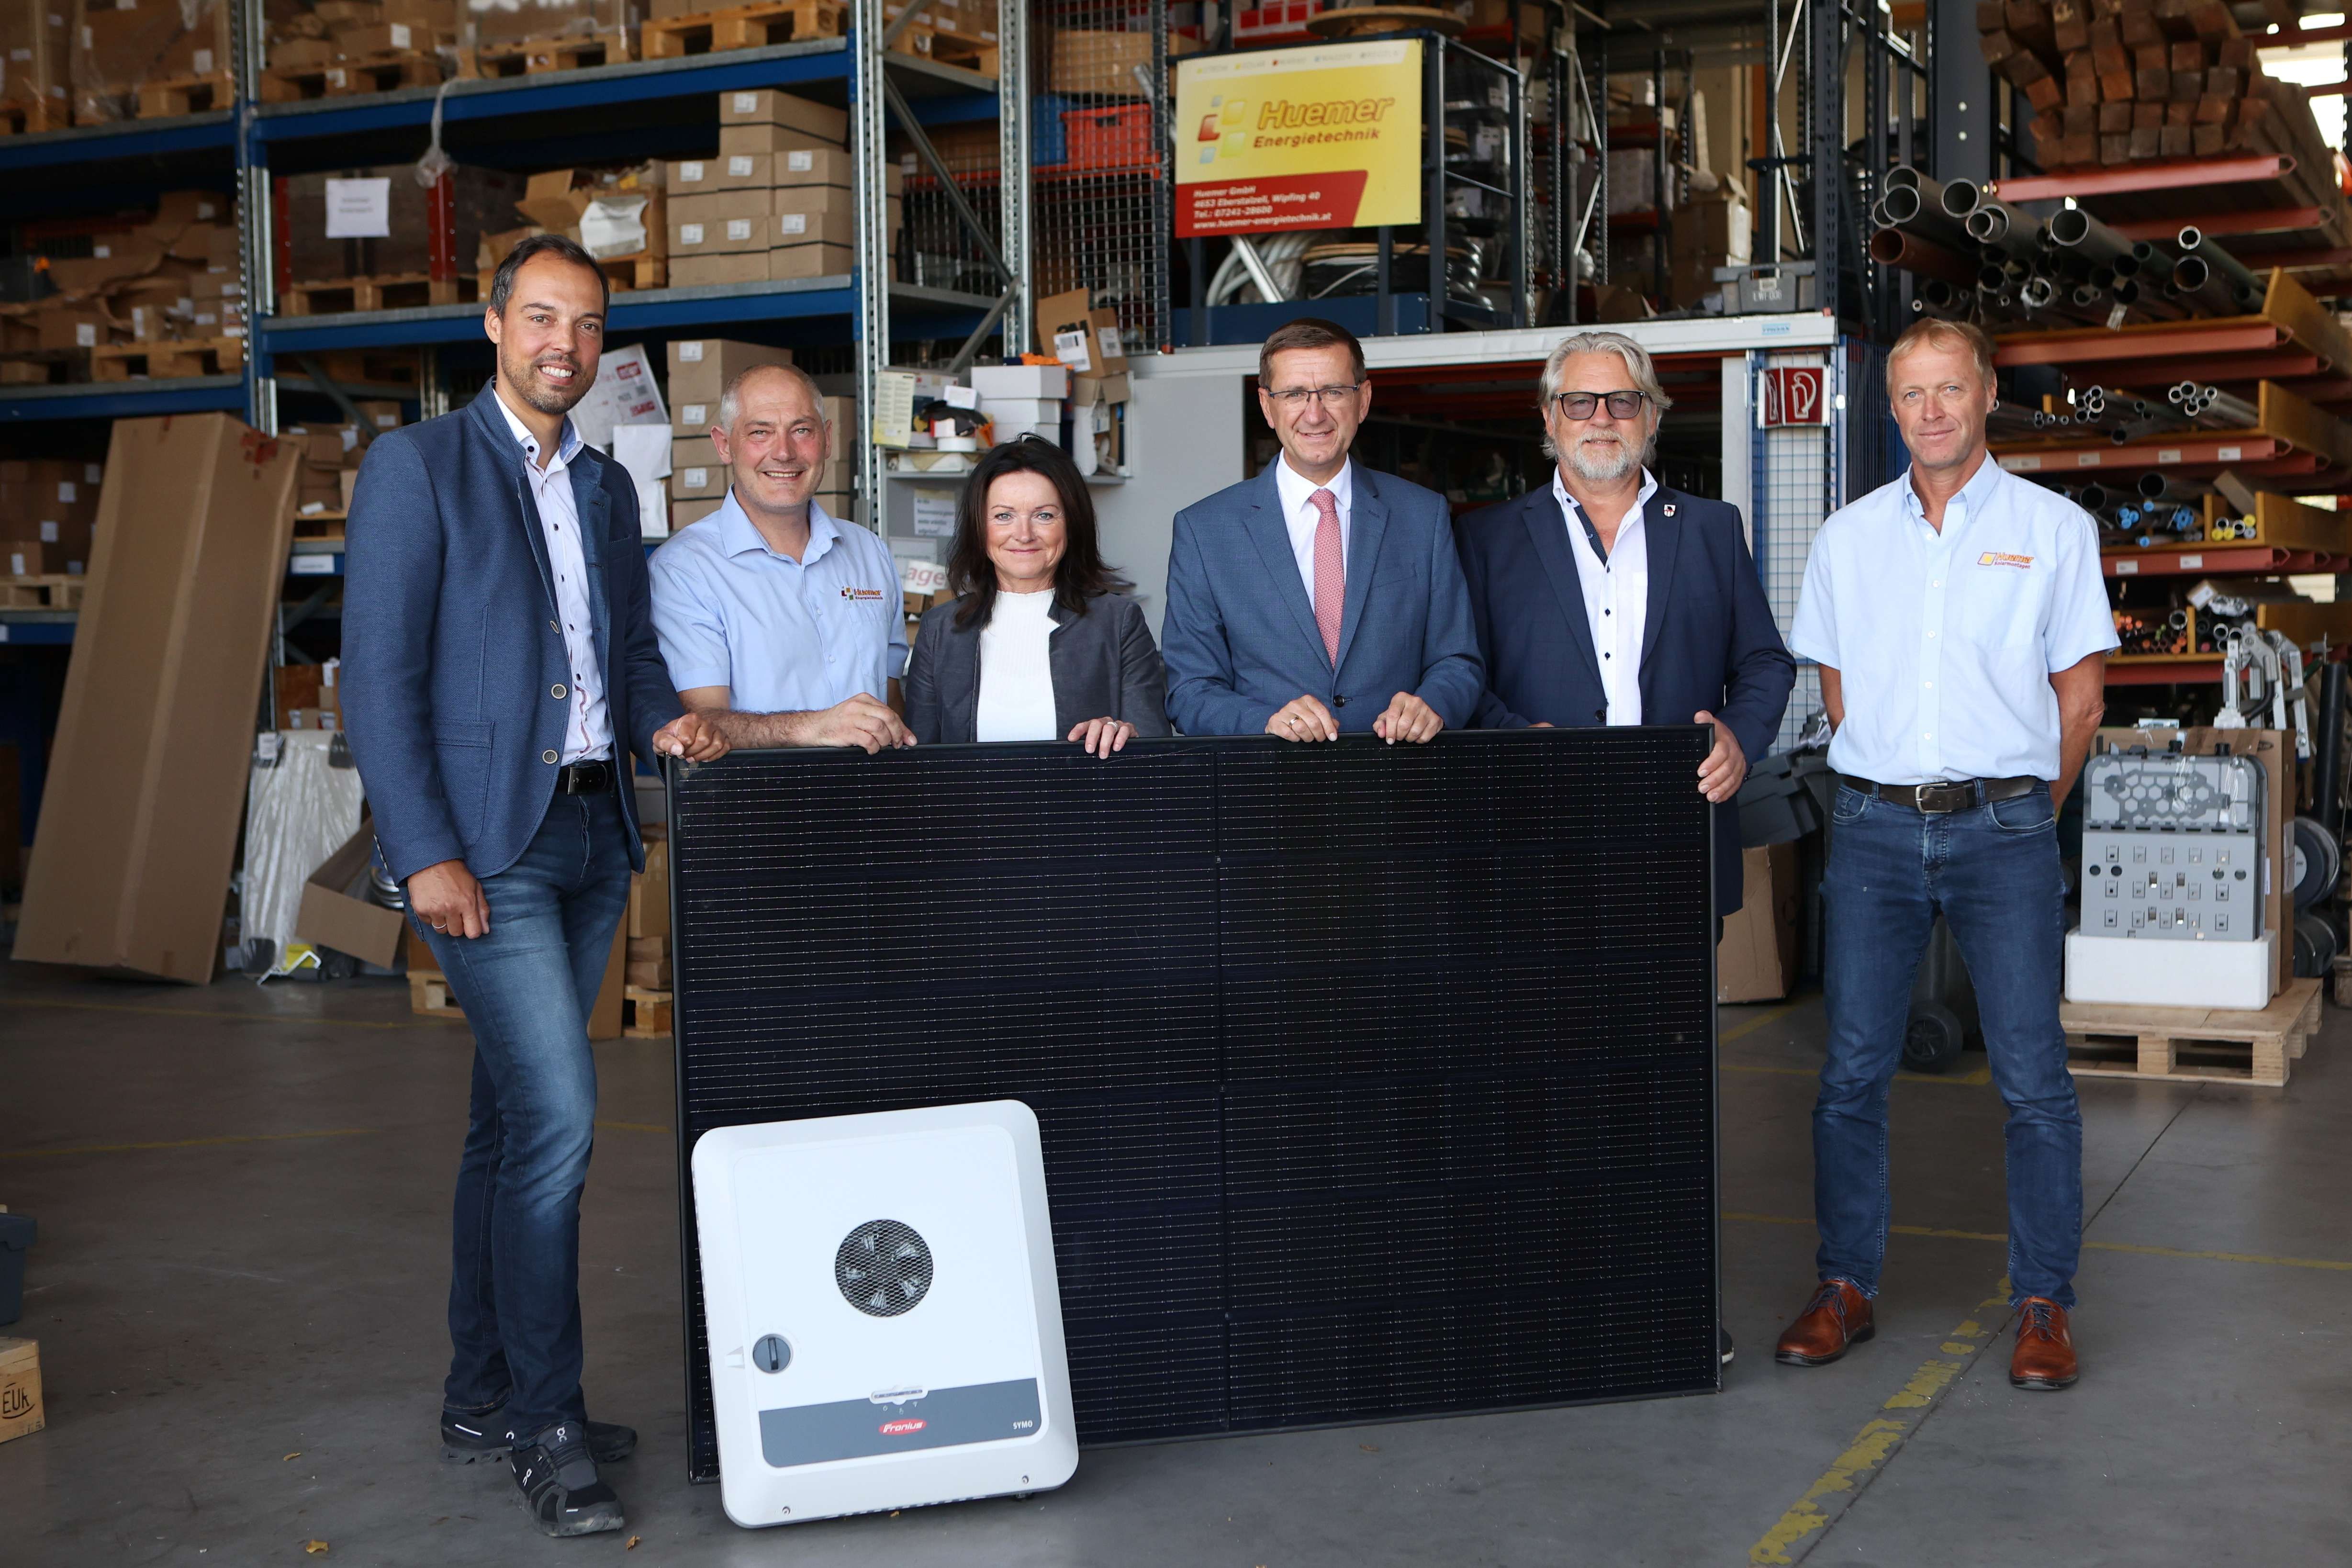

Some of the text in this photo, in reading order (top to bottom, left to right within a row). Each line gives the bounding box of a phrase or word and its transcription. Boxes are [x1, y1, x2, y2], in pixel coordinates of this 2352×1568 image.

[1257, 97, 1395, 130] Huemer
[1253, 128, 1379, 147] Energietechnik
[1193, 185, 1256, 197] Huemer GmbH
[1193, 212, 1332, 229] www.huemer-energietechnik.at
[1995, 552, 2034, 564] Huemer
[883, 1421, 923, 1434] Fronius
[1013, 1420, 1033, 1430] SYMO
